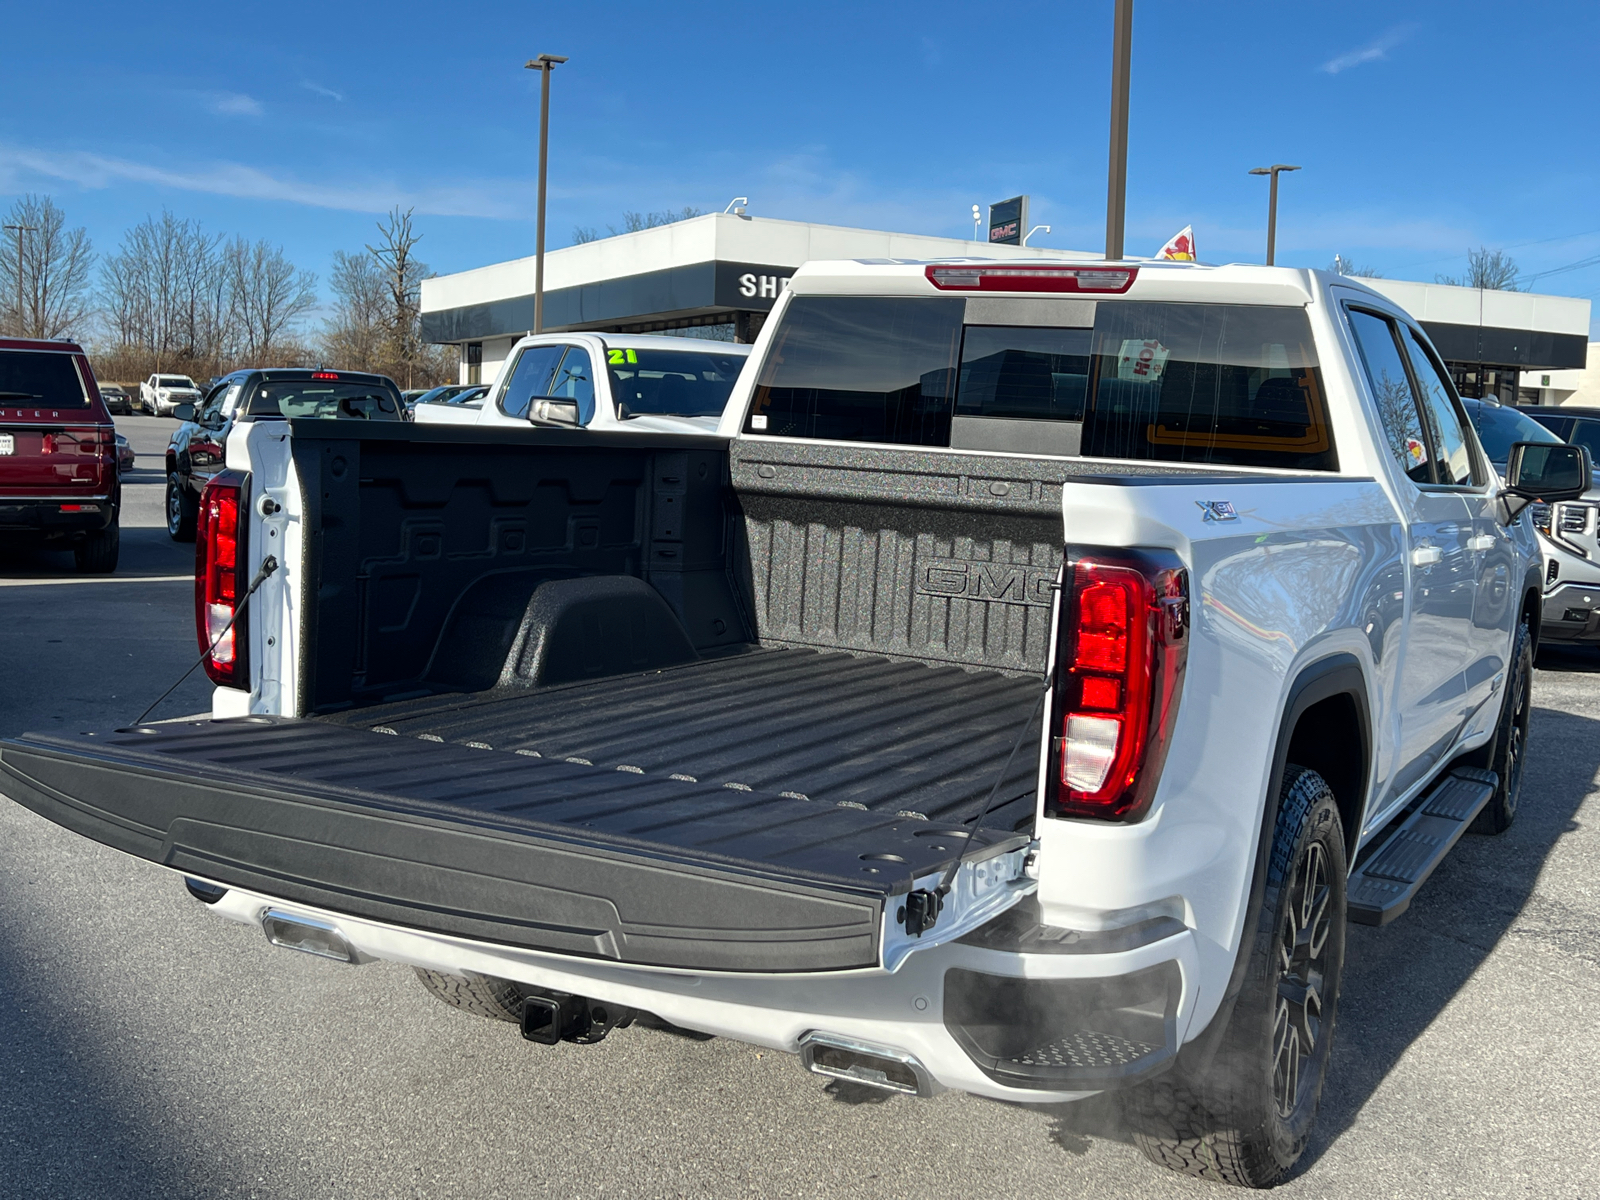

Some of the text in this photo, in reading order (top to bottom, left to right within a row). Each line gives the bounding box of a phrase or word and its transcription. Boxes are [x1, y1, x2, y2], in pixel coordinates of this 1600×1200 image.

[991, 223, 1017, 240] GMC
[607, 349, 638, 364] 21
[917, 562, 1058, 603] GMC
